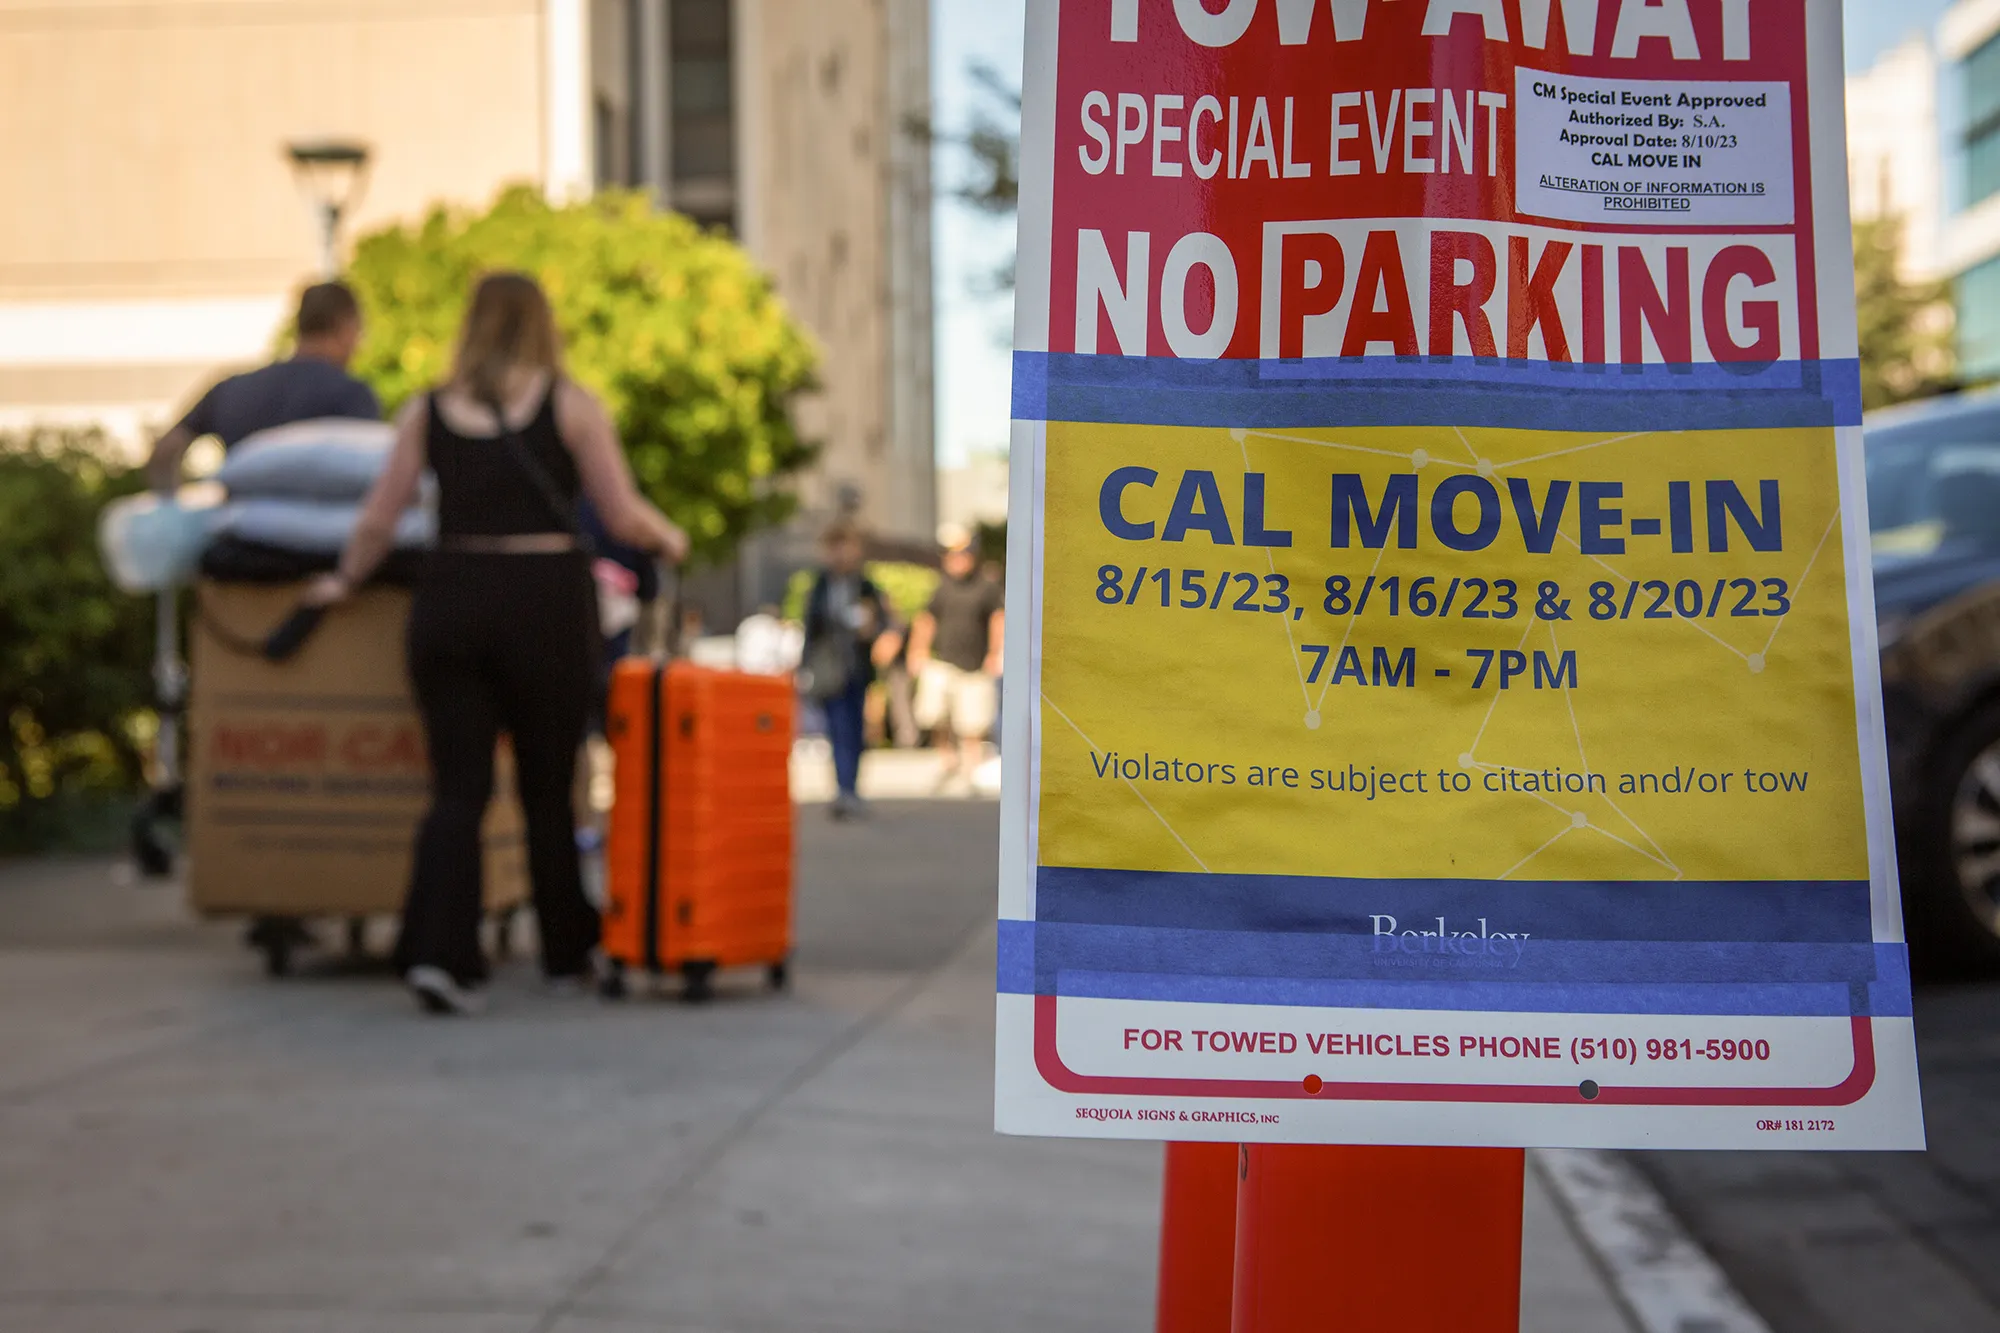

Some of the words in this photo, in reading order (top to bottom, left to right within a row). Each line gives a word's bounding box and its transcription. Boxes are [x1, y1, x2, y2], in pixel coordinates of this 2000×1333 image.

[1533, 82, 1556, 99] CM
[1560, 86, 1615, 106] Special
[1621, 92, 1672, 107] Event
[1676, 92, 1767, 110] Approved
[1078, 90, 1311, 180] SPECIAL
[1329, 88, 1507, 177] EVENT
[1569, 109, 1653, 128] Authorized
[1658, 114, 1684, 131] By:
[1693, 115, 1726, 128] S.A.
[1559, 129, 1628, 147] Approval
[1633, 132, 1677, 148] Date:
[1681, 134, 1738, 149] 8/10/23
[1591, 152, 1623, 167] CAL
[1627, 154, 1678, 168] MOVE
[1683, 155, 1701, 168] IN
[1539, 174, 1619, 193] ALTERATION
[1623, 181, 1642, 193] OF
[1646, 182, 1747, 194] INFORMATION
[1751, 182, 1765, 193] IS
[1604, 196, 1690, 209] PROHIBITED
[1074, 228, 1239, 364] NO
[1278, 230, 1782, 375] PARKING
[1099, 466, 1293, 548] CAL
[1331, 473, 1783, 555] MOVE-IN
[1095, 564, 1304, 620] 8/15/23,
[1323, 575, 1519, 620] 8/16/23
[1535, 579, 1573, 621] &
[1589, 577, 1791, 620] 8/20/23
[1301, 644, 1416, 687] 7AM
[1435, 668, 1450, 677] -
[1466, 648, 1578, 690] 7PM
[1089, 751, 1236, 785] Violators
[1247, 765, 1299, 788] are
[1310, 764, 1428, 800] subject
[1439, 768, 1471, 793] to
[1483, 766, 1606, 793] citation
[1618, 766, 1737, 794] and/or
[1744, 768, 1809, 793] tow
[1369, 914, 1531, 968] Berkeley
[1123, 1028, 1183, 1051] FOR
[1192, 1030, 1297, 1054] TOWED
[1306, 1033, 1450, 1057] VEHICLES
[1460, 1036, 1561, 1059] PHONE
[1570, 1037, 1637, 1065] (510)
[1646, 1038, 1770, 1060] 981-5900
[1075, 1108, 1133, 1121] SEQUOIA
[1137, 1109, 1175, 1121] SIGNS
[1179, 1111, 1189, 1121] &
[1191, 1111, 1259, 1124] GRAPHICS,
[1260, 1115, 1280, 1124] INC
[1756, 1120, 1782, 1131] OR#
[1785, 1120, 1804, 1131] 181
[1807, 1120, 1835, 1131] 2172
